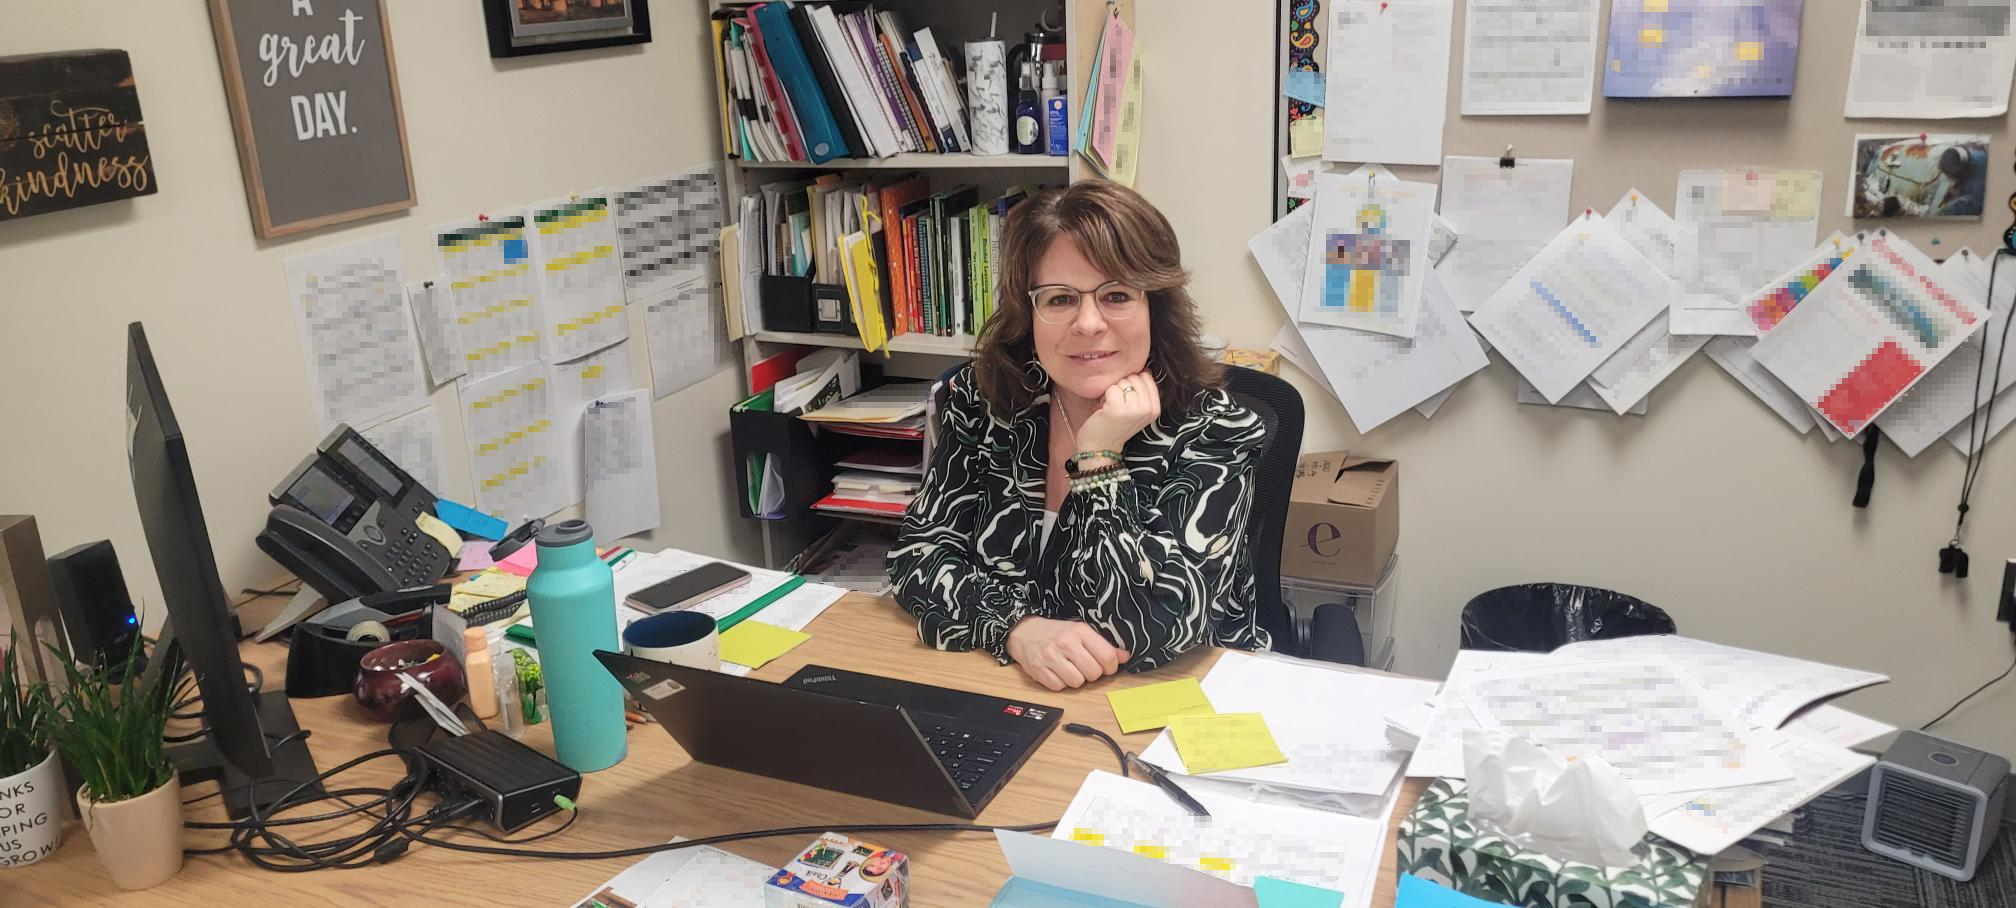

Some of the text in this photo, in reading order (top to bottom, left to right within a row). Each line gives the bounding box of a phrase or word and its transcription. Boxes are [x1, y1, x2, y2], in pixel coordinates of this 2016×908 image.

[259, 8, 365, 87] great
[28, 100, 128, 160] scatter
[290, 90, 358, 141] DAY.
[0, 151, 149, 215] kindness
[0, 781, 34, 800] NKS
[0, 803, 26, 818] OR
[1, 812, 48, 837] PING
[806, 869, 828, 881] Chalk
